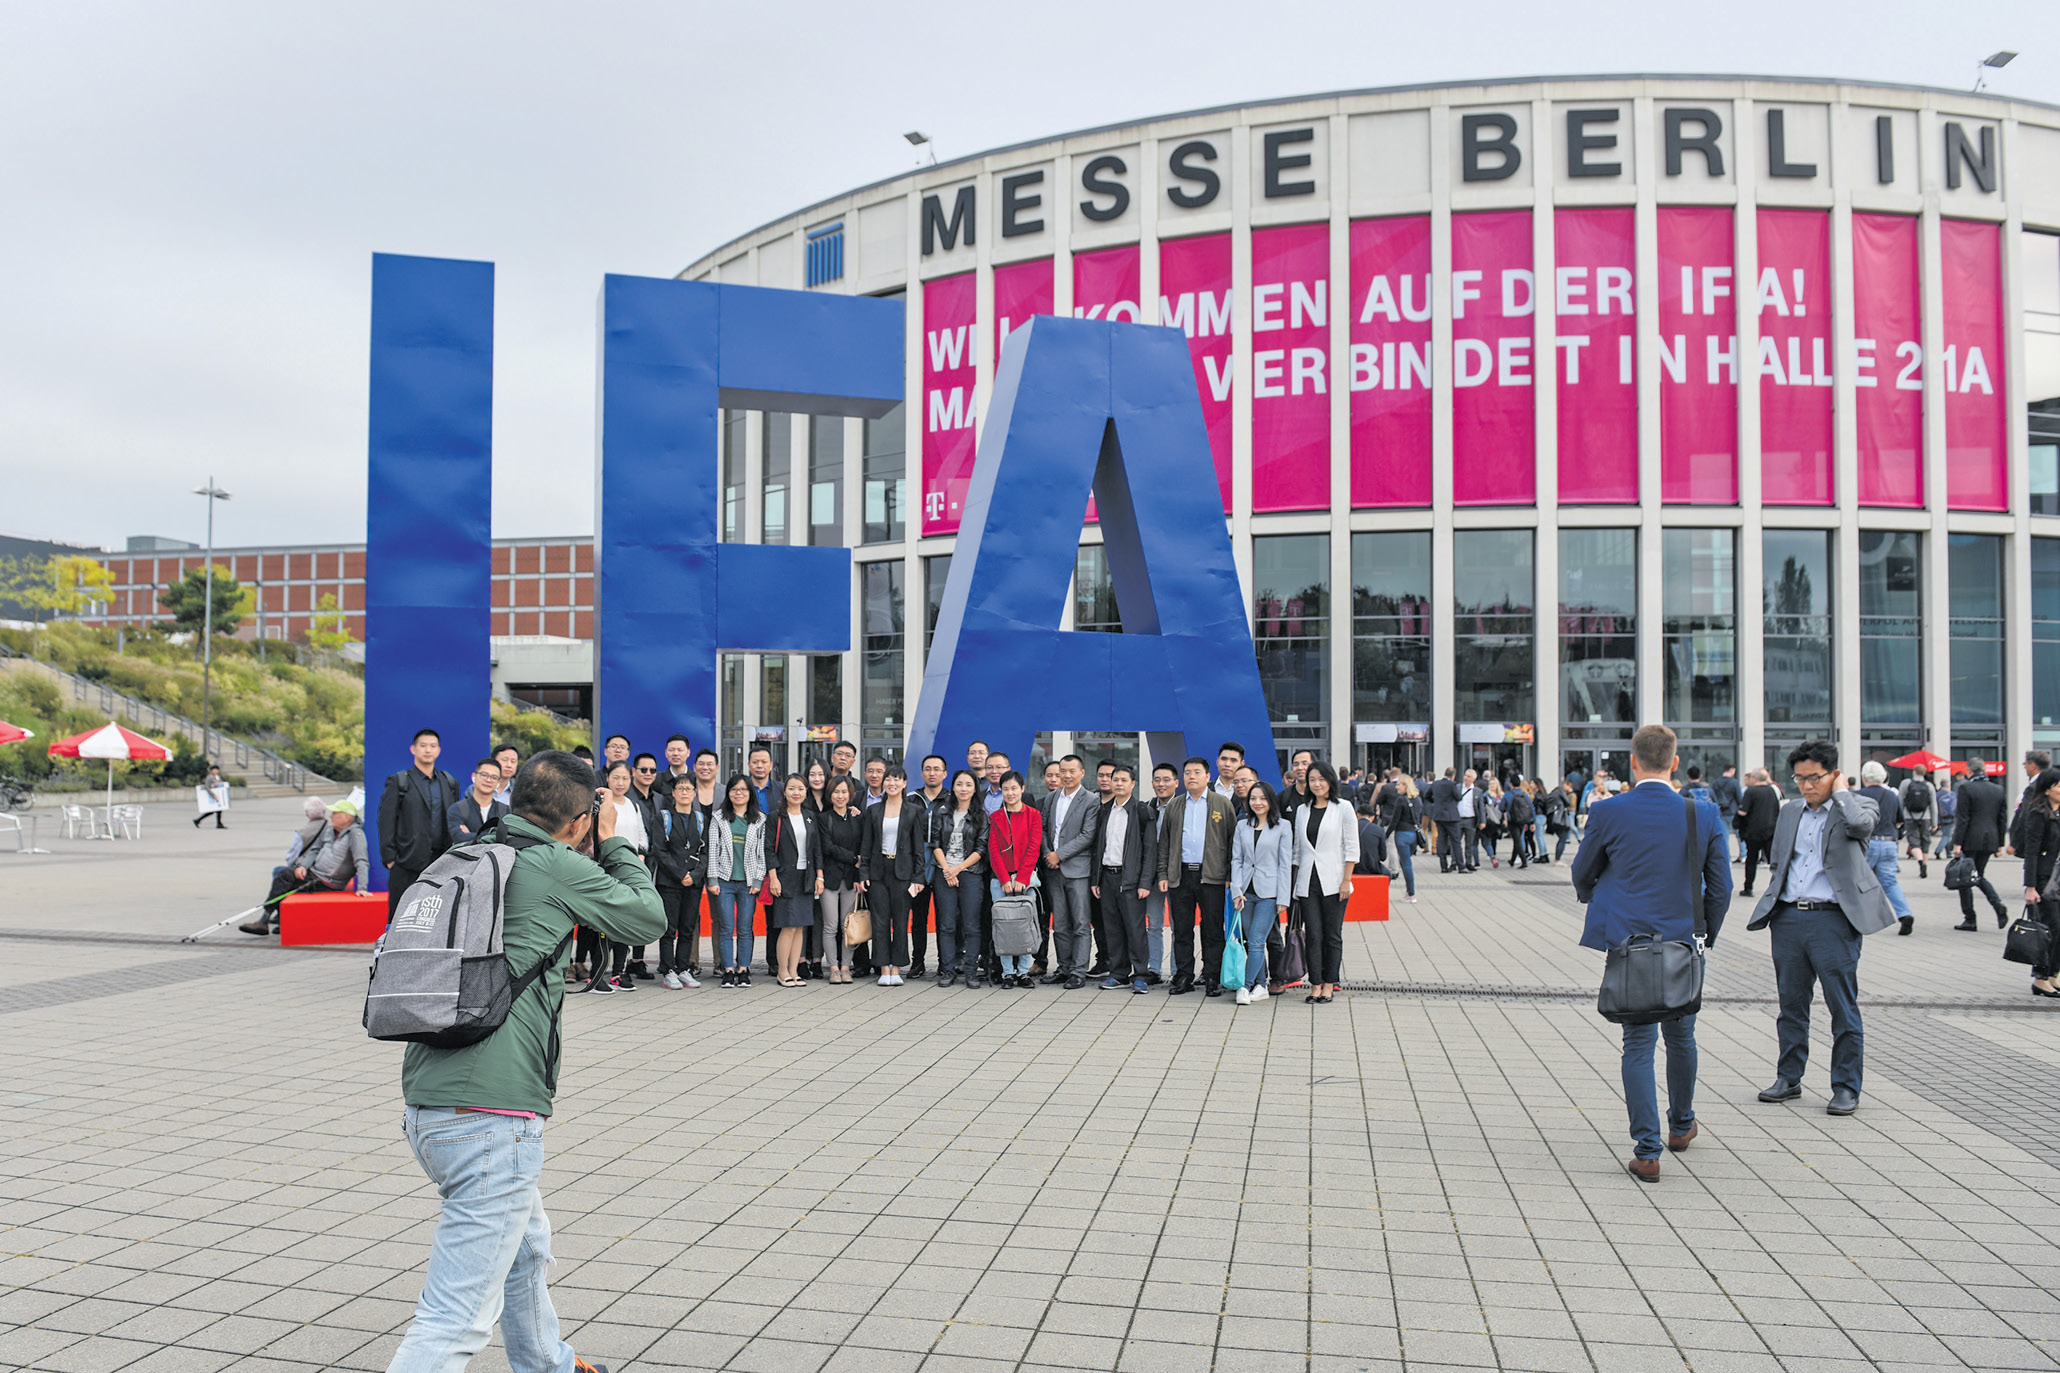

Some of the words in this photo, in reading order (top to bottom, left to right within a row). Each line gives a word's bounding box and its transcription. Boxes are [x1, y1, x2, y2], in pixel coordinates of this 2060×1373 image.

[921, 127, 1316, 256] MESSE
[1461, 107, 1998, 193] BERLIN
[1359, 269, 1483, 324] AUF
[1501, 266, 1635, 317] DER
[1681, 265, 1806, 317] IFA!
[1202, 334, 1591, 402] VERBINDET
[1618, 334, 1688, 385] IN
[1706, 334, 1878, 388] HALLE
[1895, 340, 1995, 395] 21A
[364, 252, 1282, 890] IFA
[418, 906, 440, 919] 2017
